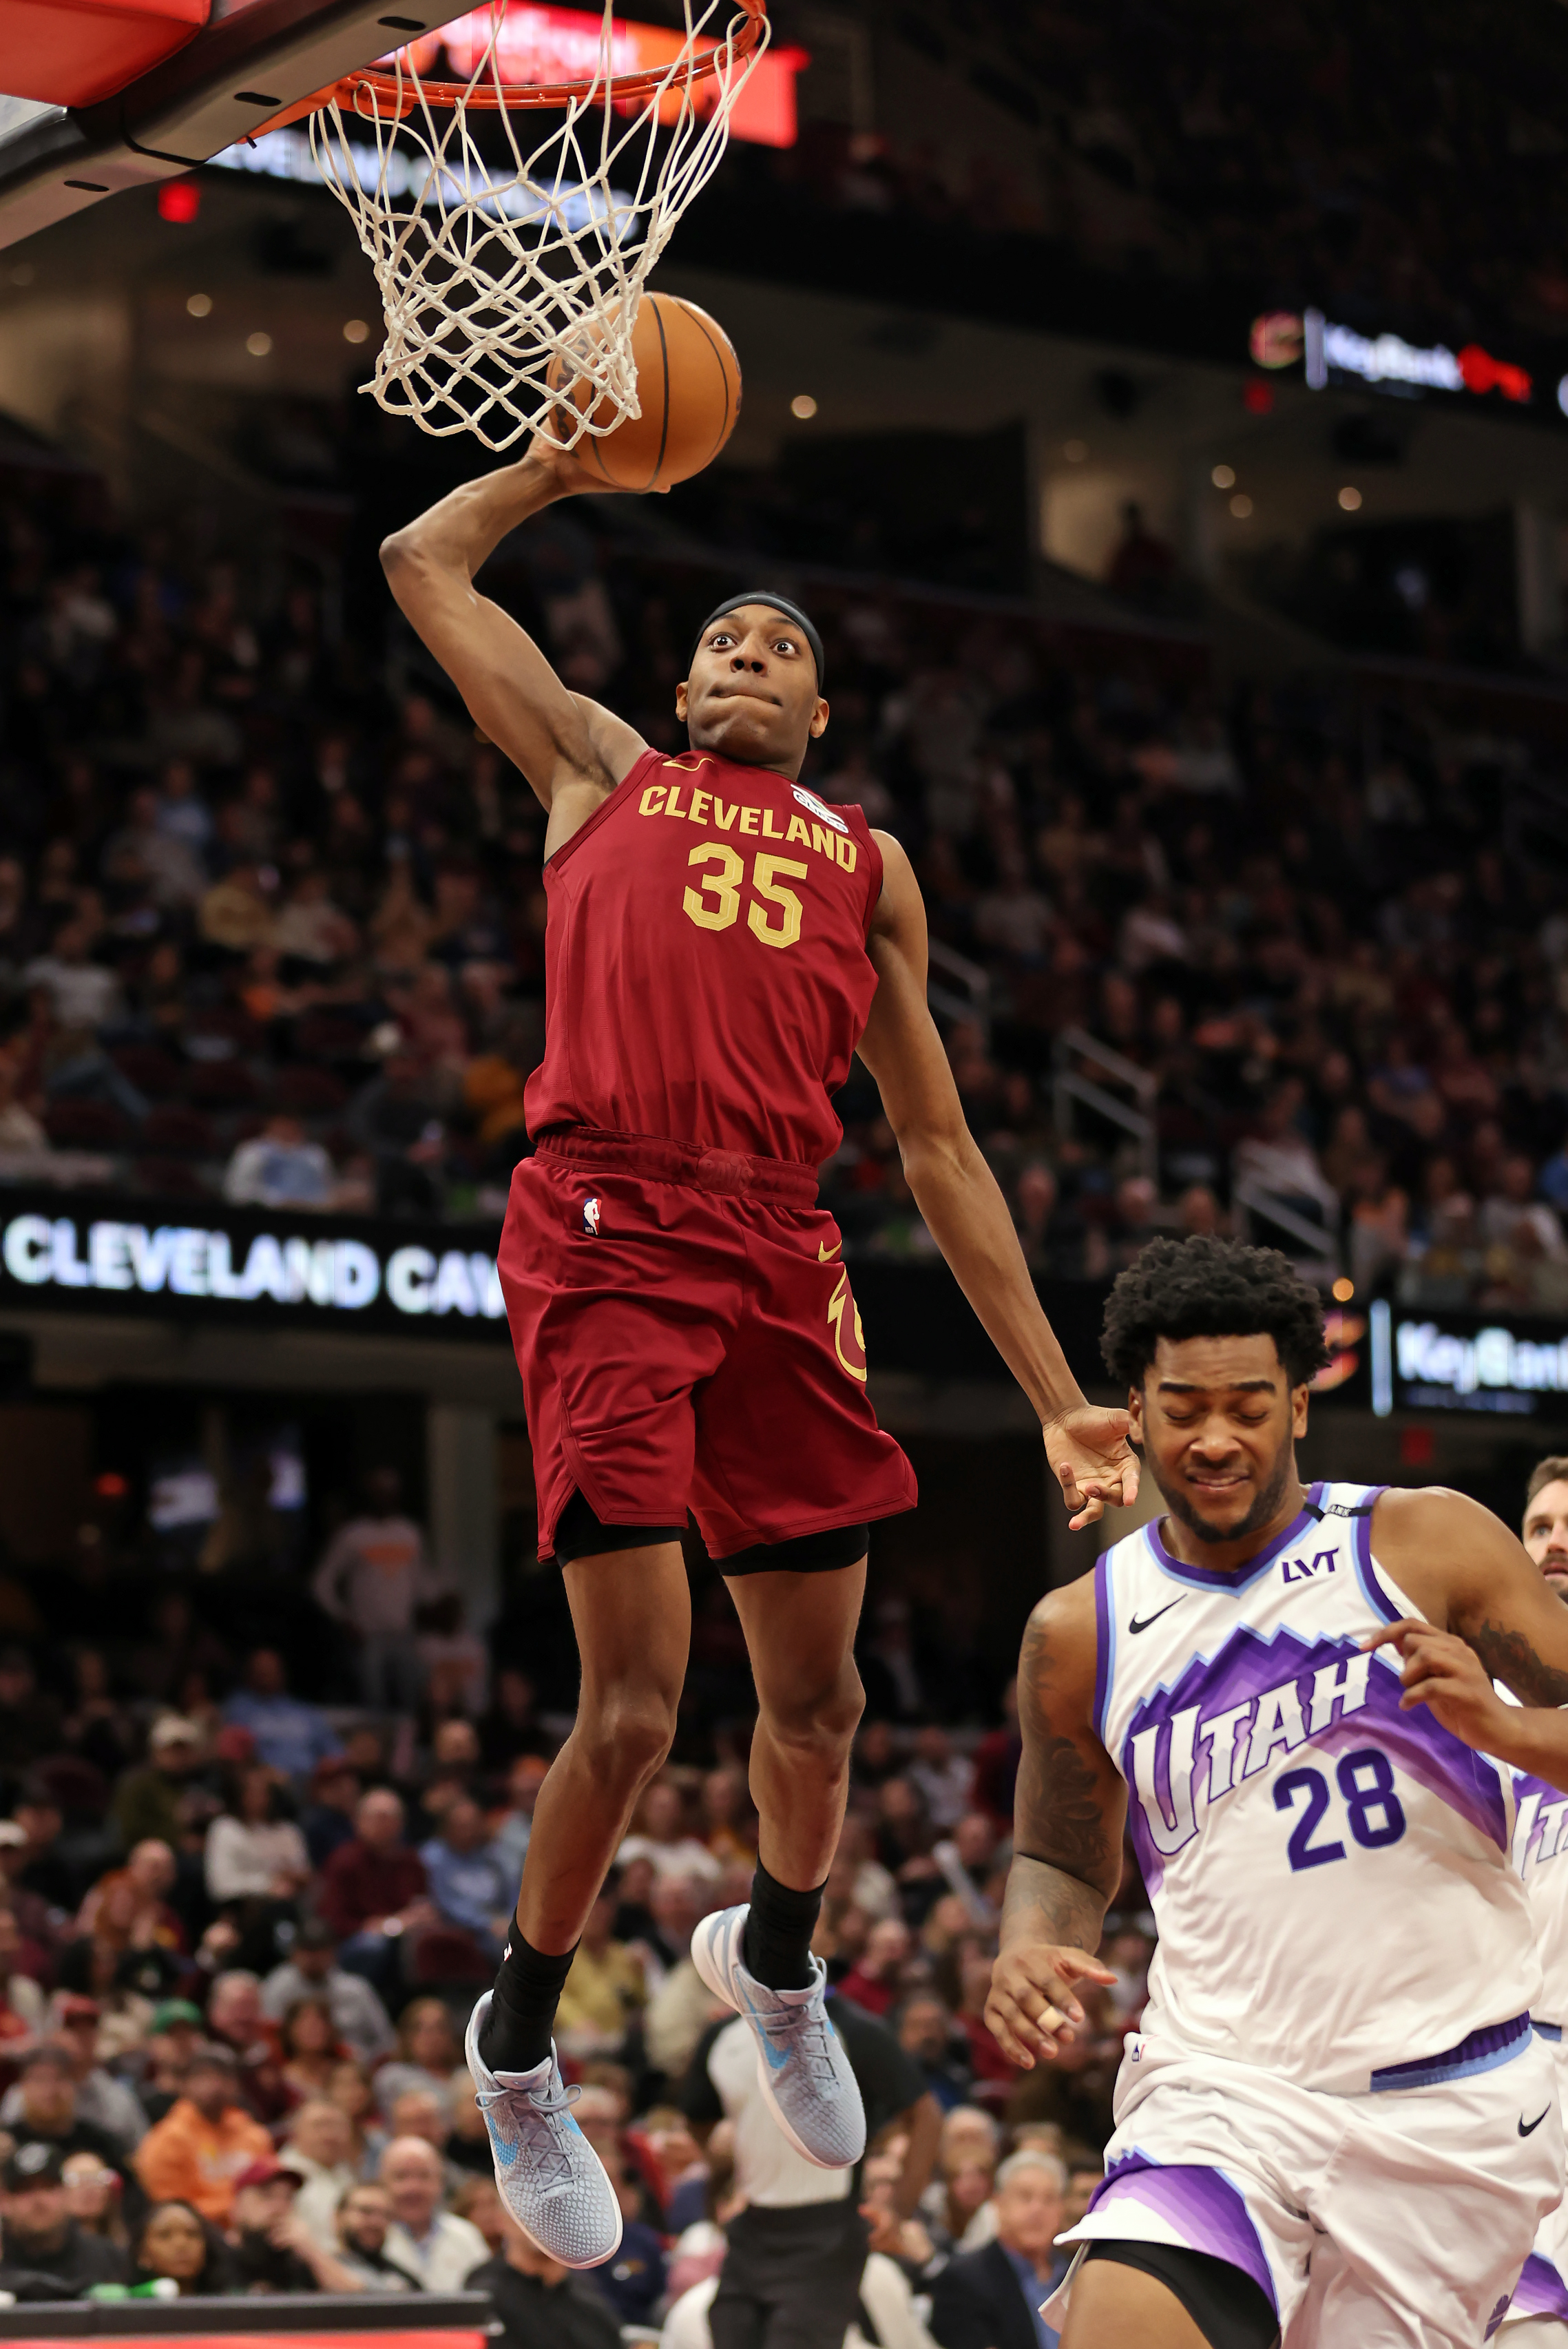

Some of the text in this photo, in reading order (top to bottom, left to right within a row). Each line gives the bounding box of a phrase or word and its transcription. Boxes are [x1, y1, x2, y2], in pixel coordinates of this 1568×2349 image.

[638, 785, 857, 873] CLEVELAND
[682, 841, 808, 949] 35
[3, 1214, 380, 1308] CLEVELAND
[1281, 1547, 1340, 1584] LVT
[1131, 1650, 1374, 1855] UTAH
[1273, 1747, 1406, 1873] 28
